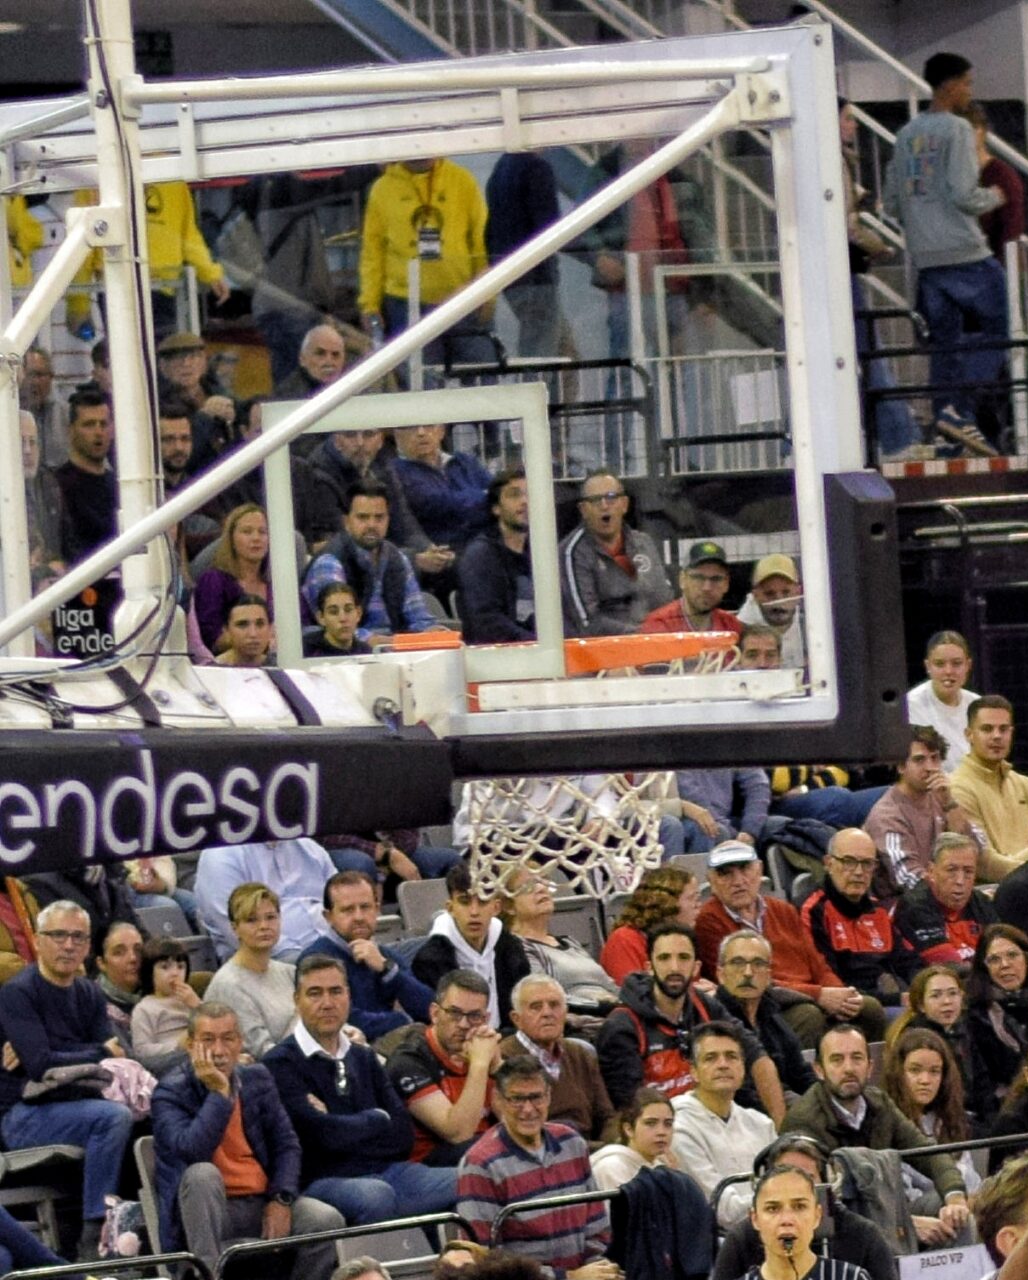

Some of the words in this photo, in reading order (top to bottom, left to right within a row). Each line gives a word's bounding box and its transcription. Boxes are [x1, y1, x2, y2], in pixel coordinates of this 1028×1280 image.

[55, 604, 95, 631] liga
[57, 629, 115, 654] ende
[0, 749, 320, 863] endesa
